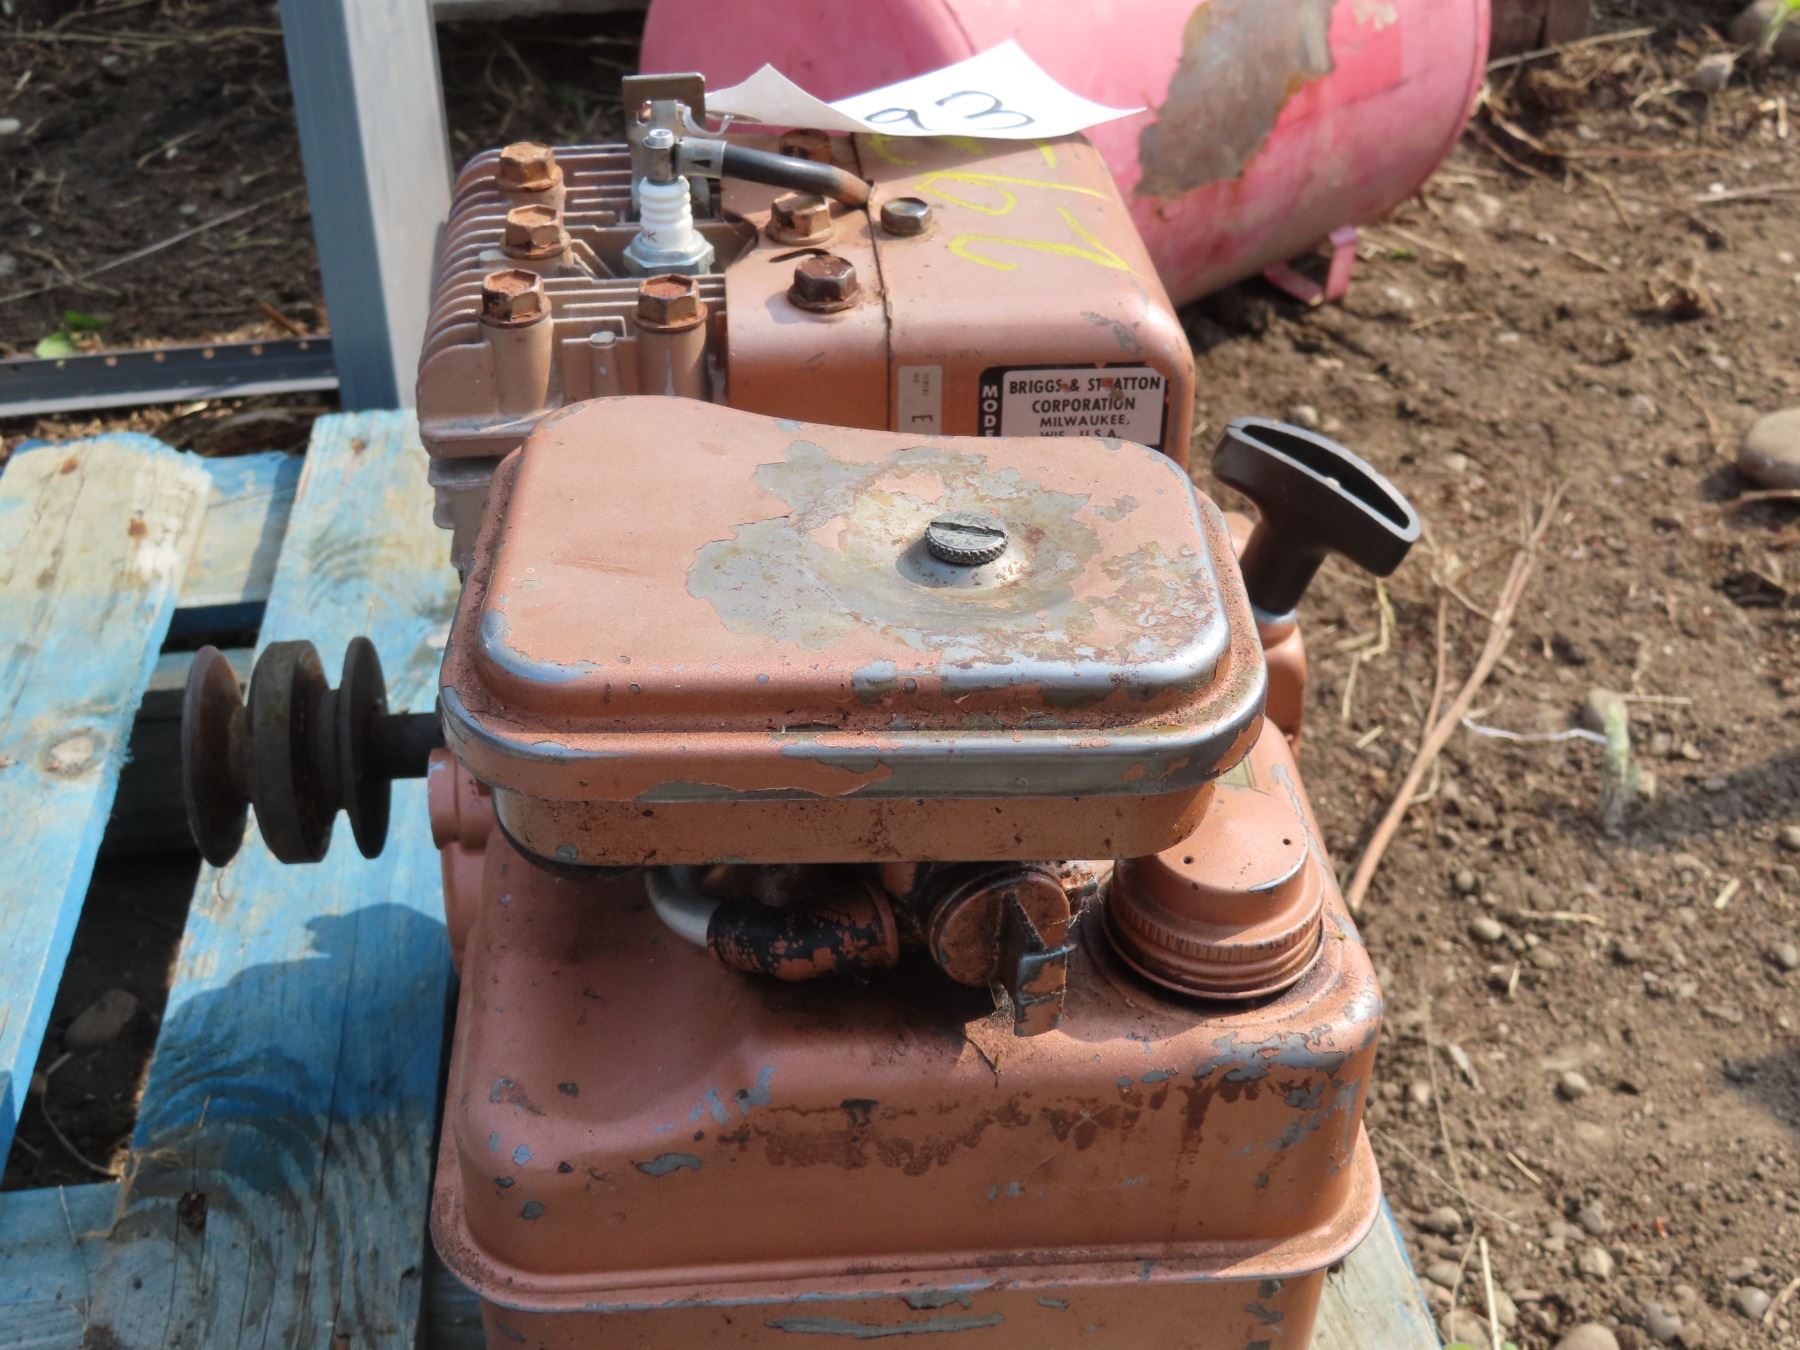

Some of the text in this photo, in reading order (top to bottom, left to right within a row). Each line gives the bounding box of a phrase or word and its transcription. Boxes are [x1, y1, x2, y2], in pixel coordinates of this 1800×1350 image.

[1009, 376, 1161, 394] BRIGGS & STATTON
[1032, 397, 1136, 413] CORPORATION
[1040, 414, 1131, 428] MILWAUKEE,
